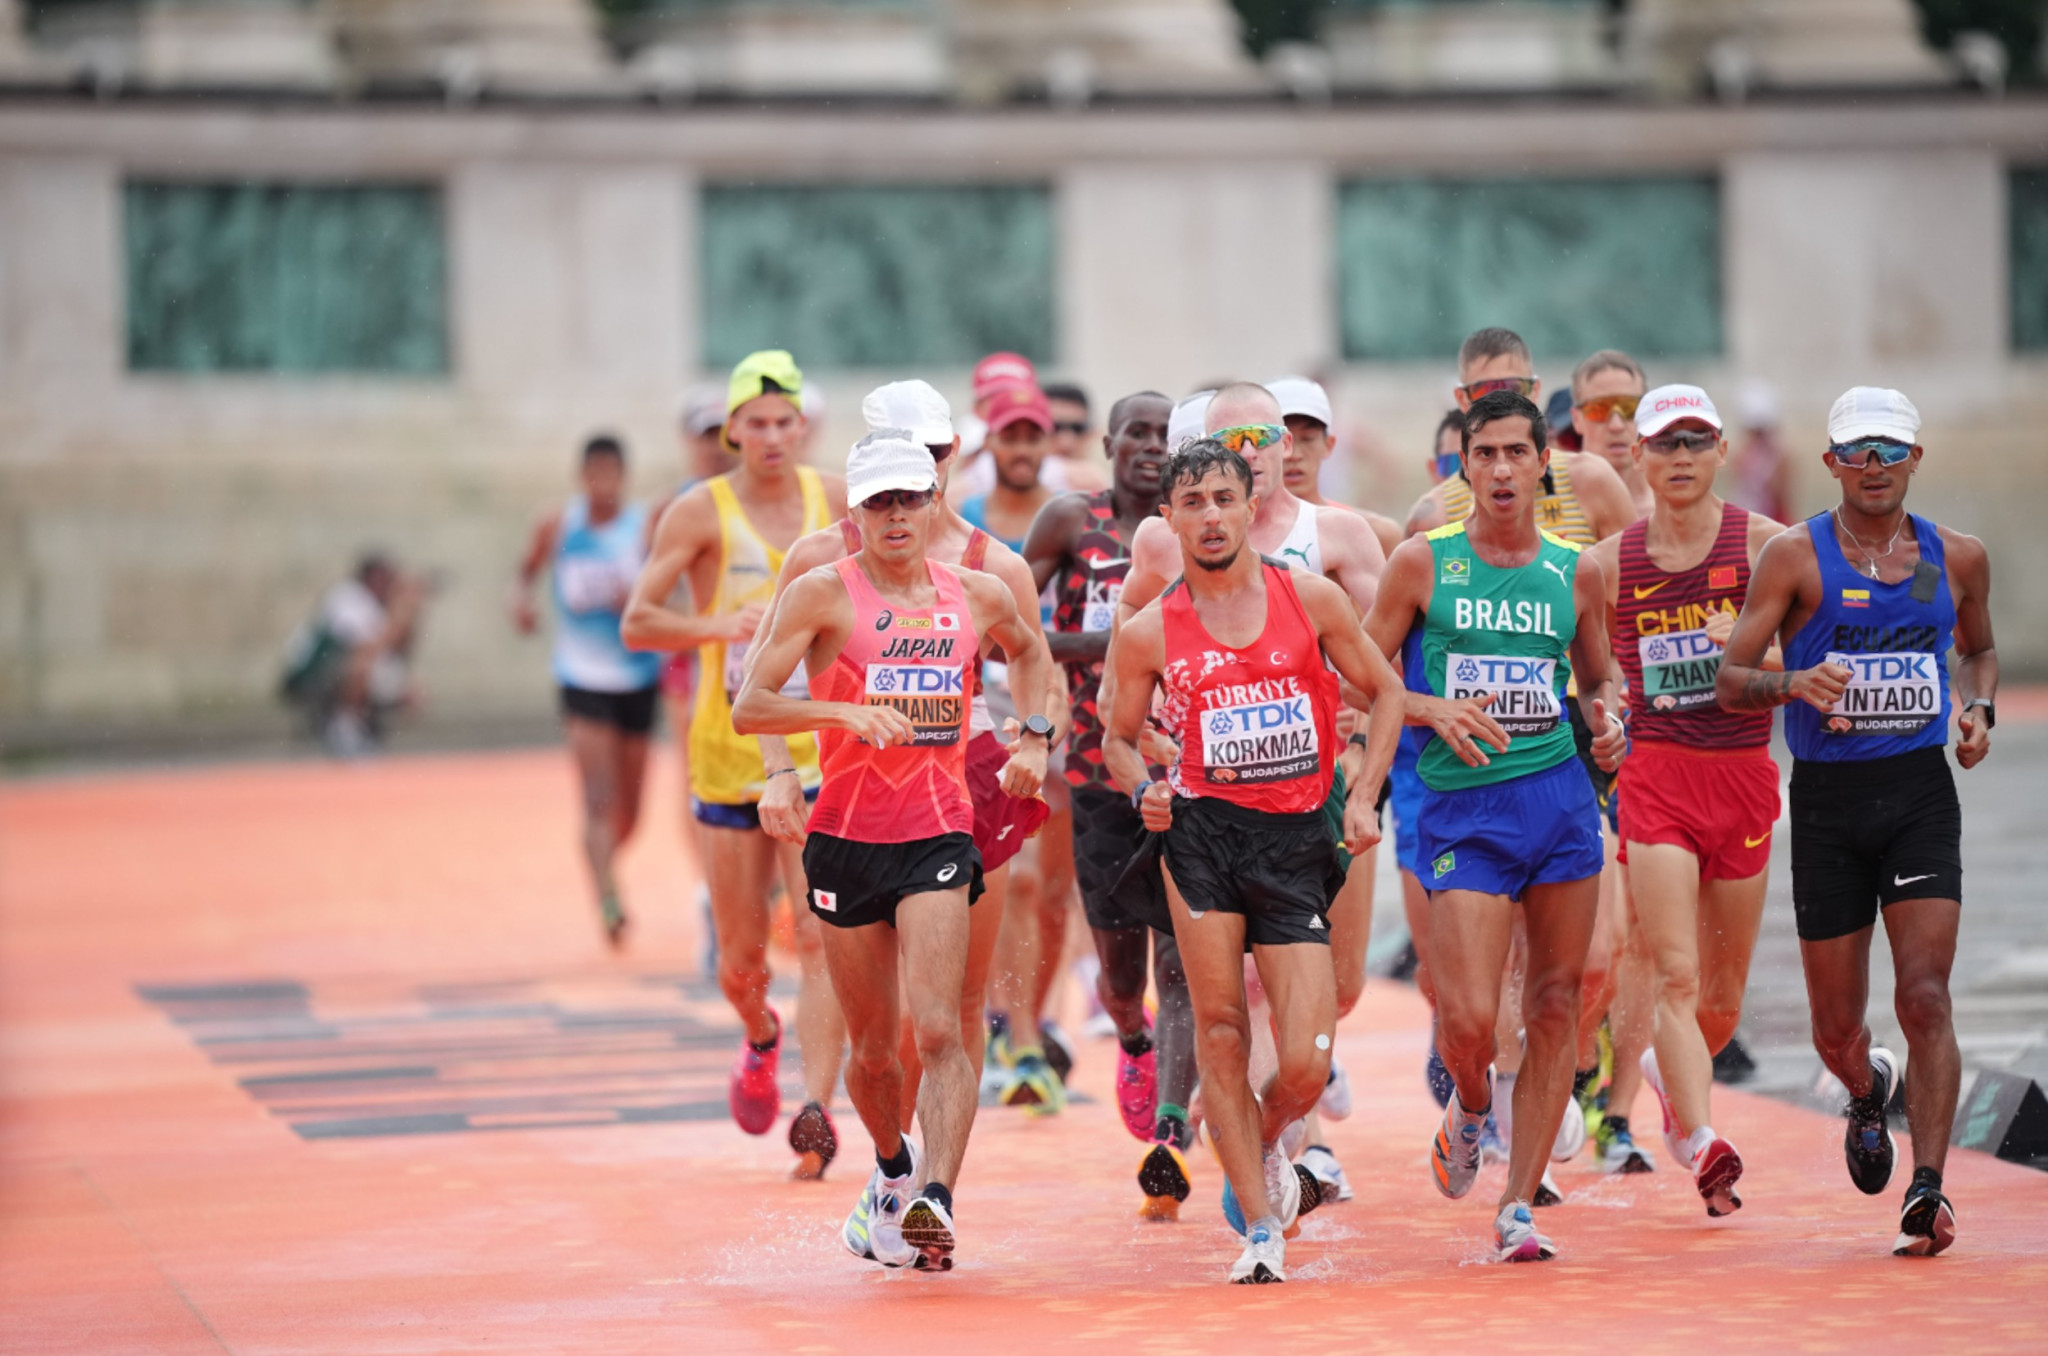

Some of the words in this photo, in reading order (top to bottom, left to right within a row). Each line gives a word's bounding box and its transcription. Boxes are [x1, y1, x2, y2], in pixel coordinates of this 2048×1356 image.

[1455, 598, 1557, 636] BRASIL
[881, 638, 955, 658] JAPAN
[1666, 633, 1723, 658] TD
[1833, 624, 1937, 652] ECUADOR
[896, 668, 962, 693] TDK
[1479, 660, 1548, 686] TDK
[1657, 658, 1720, 690] ZHAN
[1855, 657, 1930, 682] TDK
[1201, 676, 1301, 710] TÜRKİYE
[1843, 685, 1934, 712] INTADO
[1231, 698, 1306, 732] TDK
[1210, 728, 1312, 765] KORKMAZ
